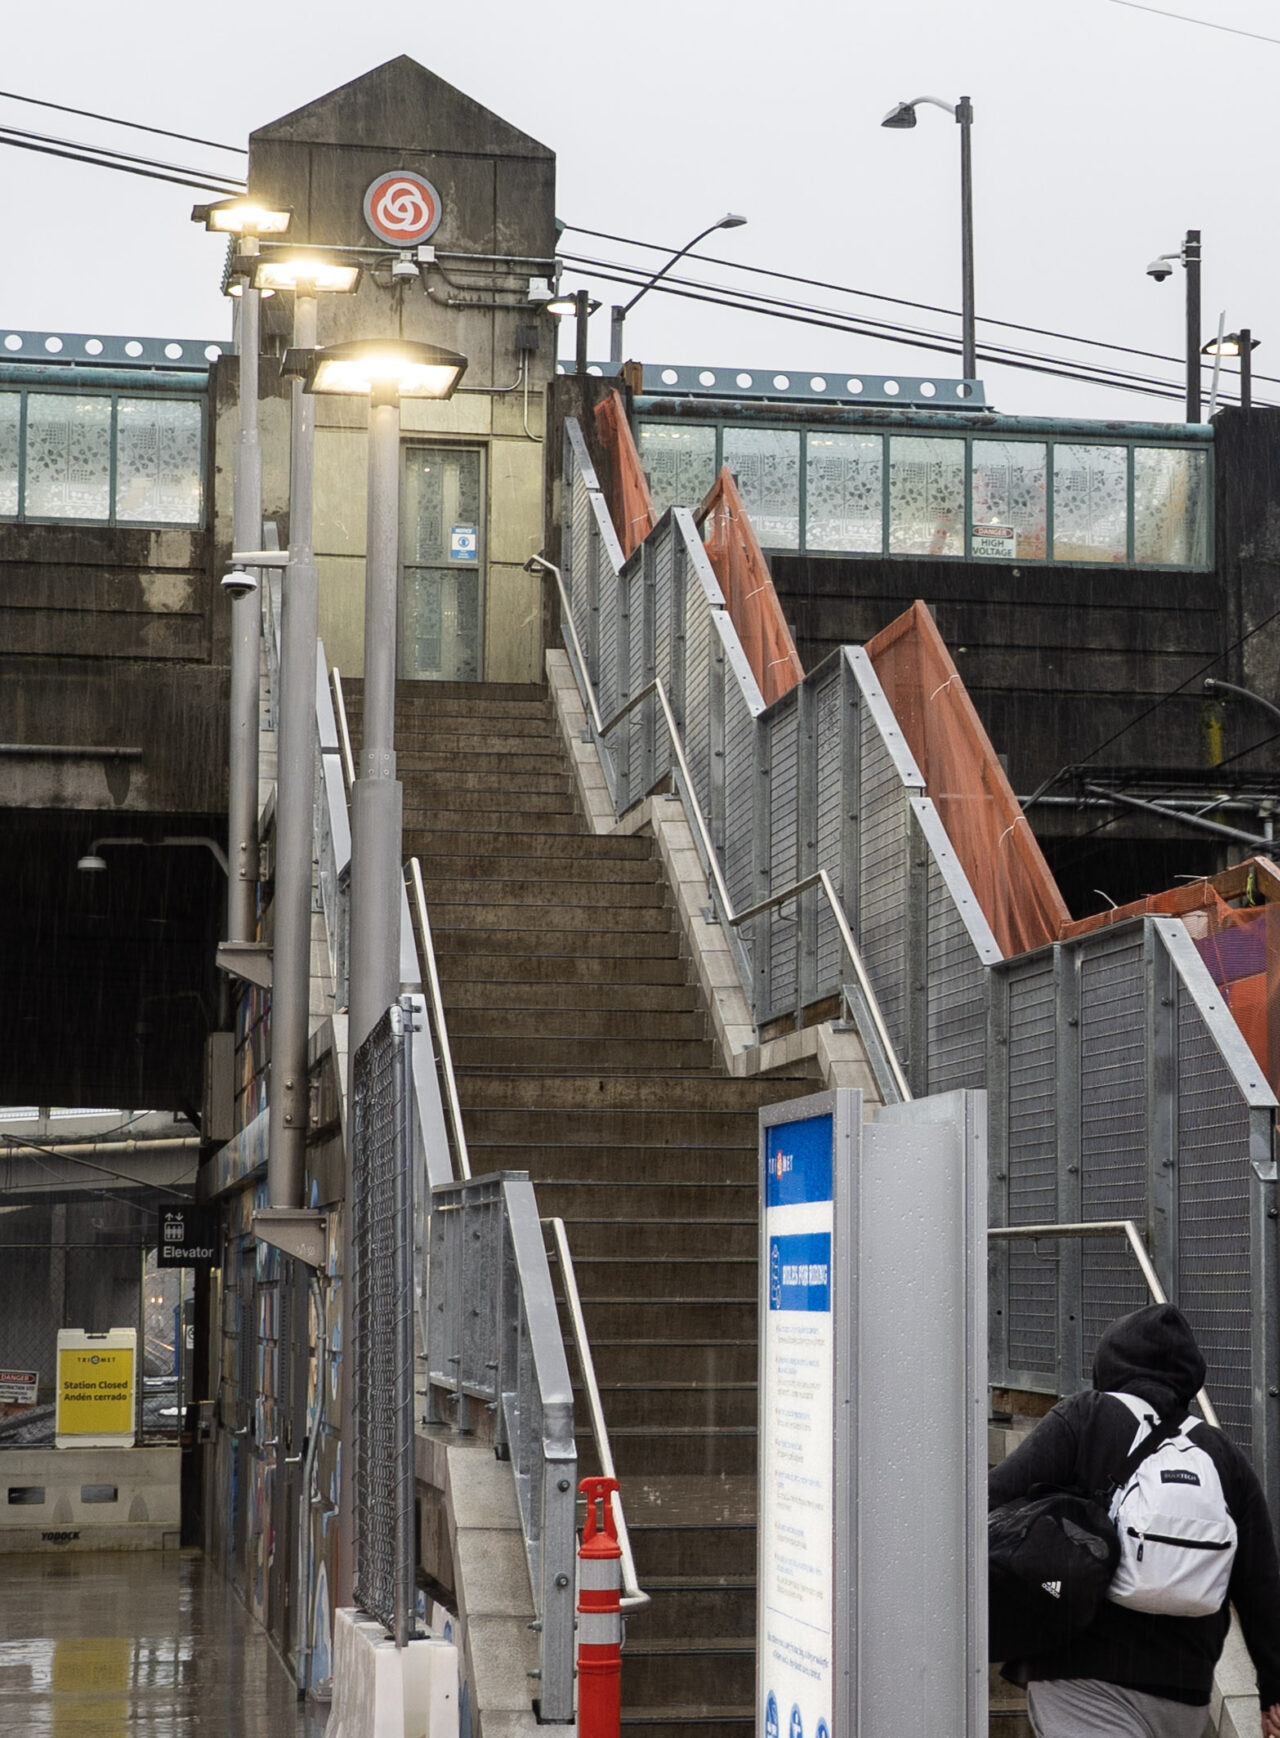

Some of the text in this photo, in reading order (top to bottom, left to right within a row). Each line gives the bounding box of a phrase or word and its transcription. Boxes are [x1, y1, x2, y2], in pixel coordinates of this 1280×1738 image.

[981, 539, 1004, 547] HIGH
[972, 547, 1012, 557] VOLTAGE
[162, 1246, 214, 1258] Elevator
[64, 1381, 128, 1389] Station Closed
[64, 1393, 92, 1401] Andén
[1041, 1582, 1061, 1599] adidas
